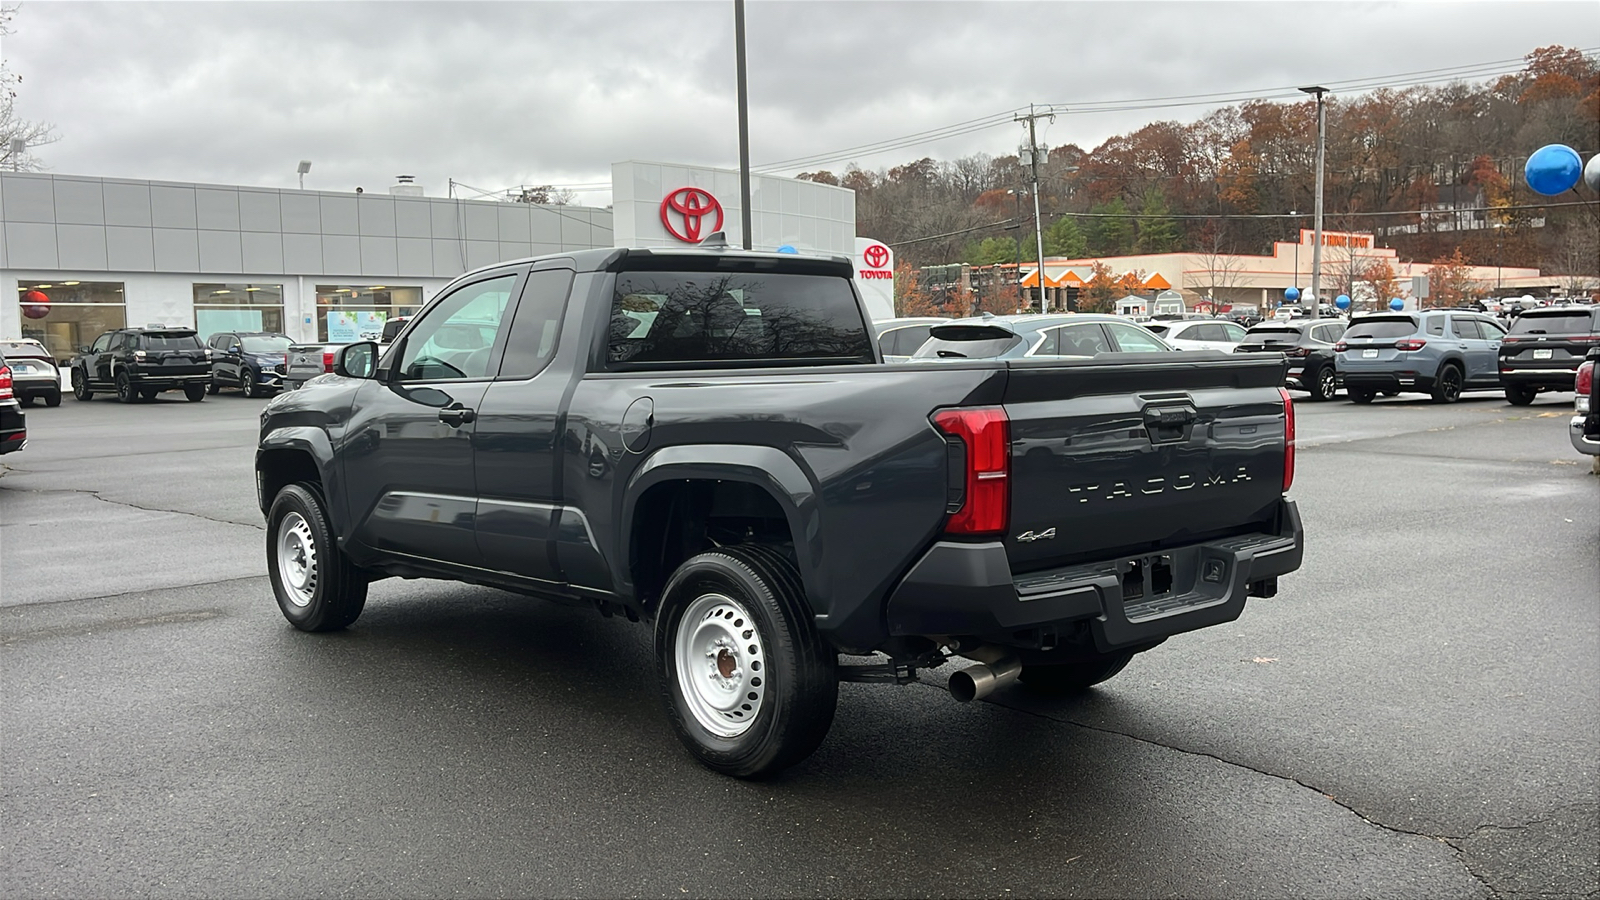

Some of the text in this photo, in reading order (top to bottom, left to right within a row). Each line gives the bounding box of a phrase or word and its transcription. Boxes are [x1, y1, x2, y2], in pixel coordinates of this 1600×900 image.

[1310, 233, 1325, 246] TE
[859, 270, 893, 280] TOYOTA
[1069, 467, 1252, 503] TACOMA
